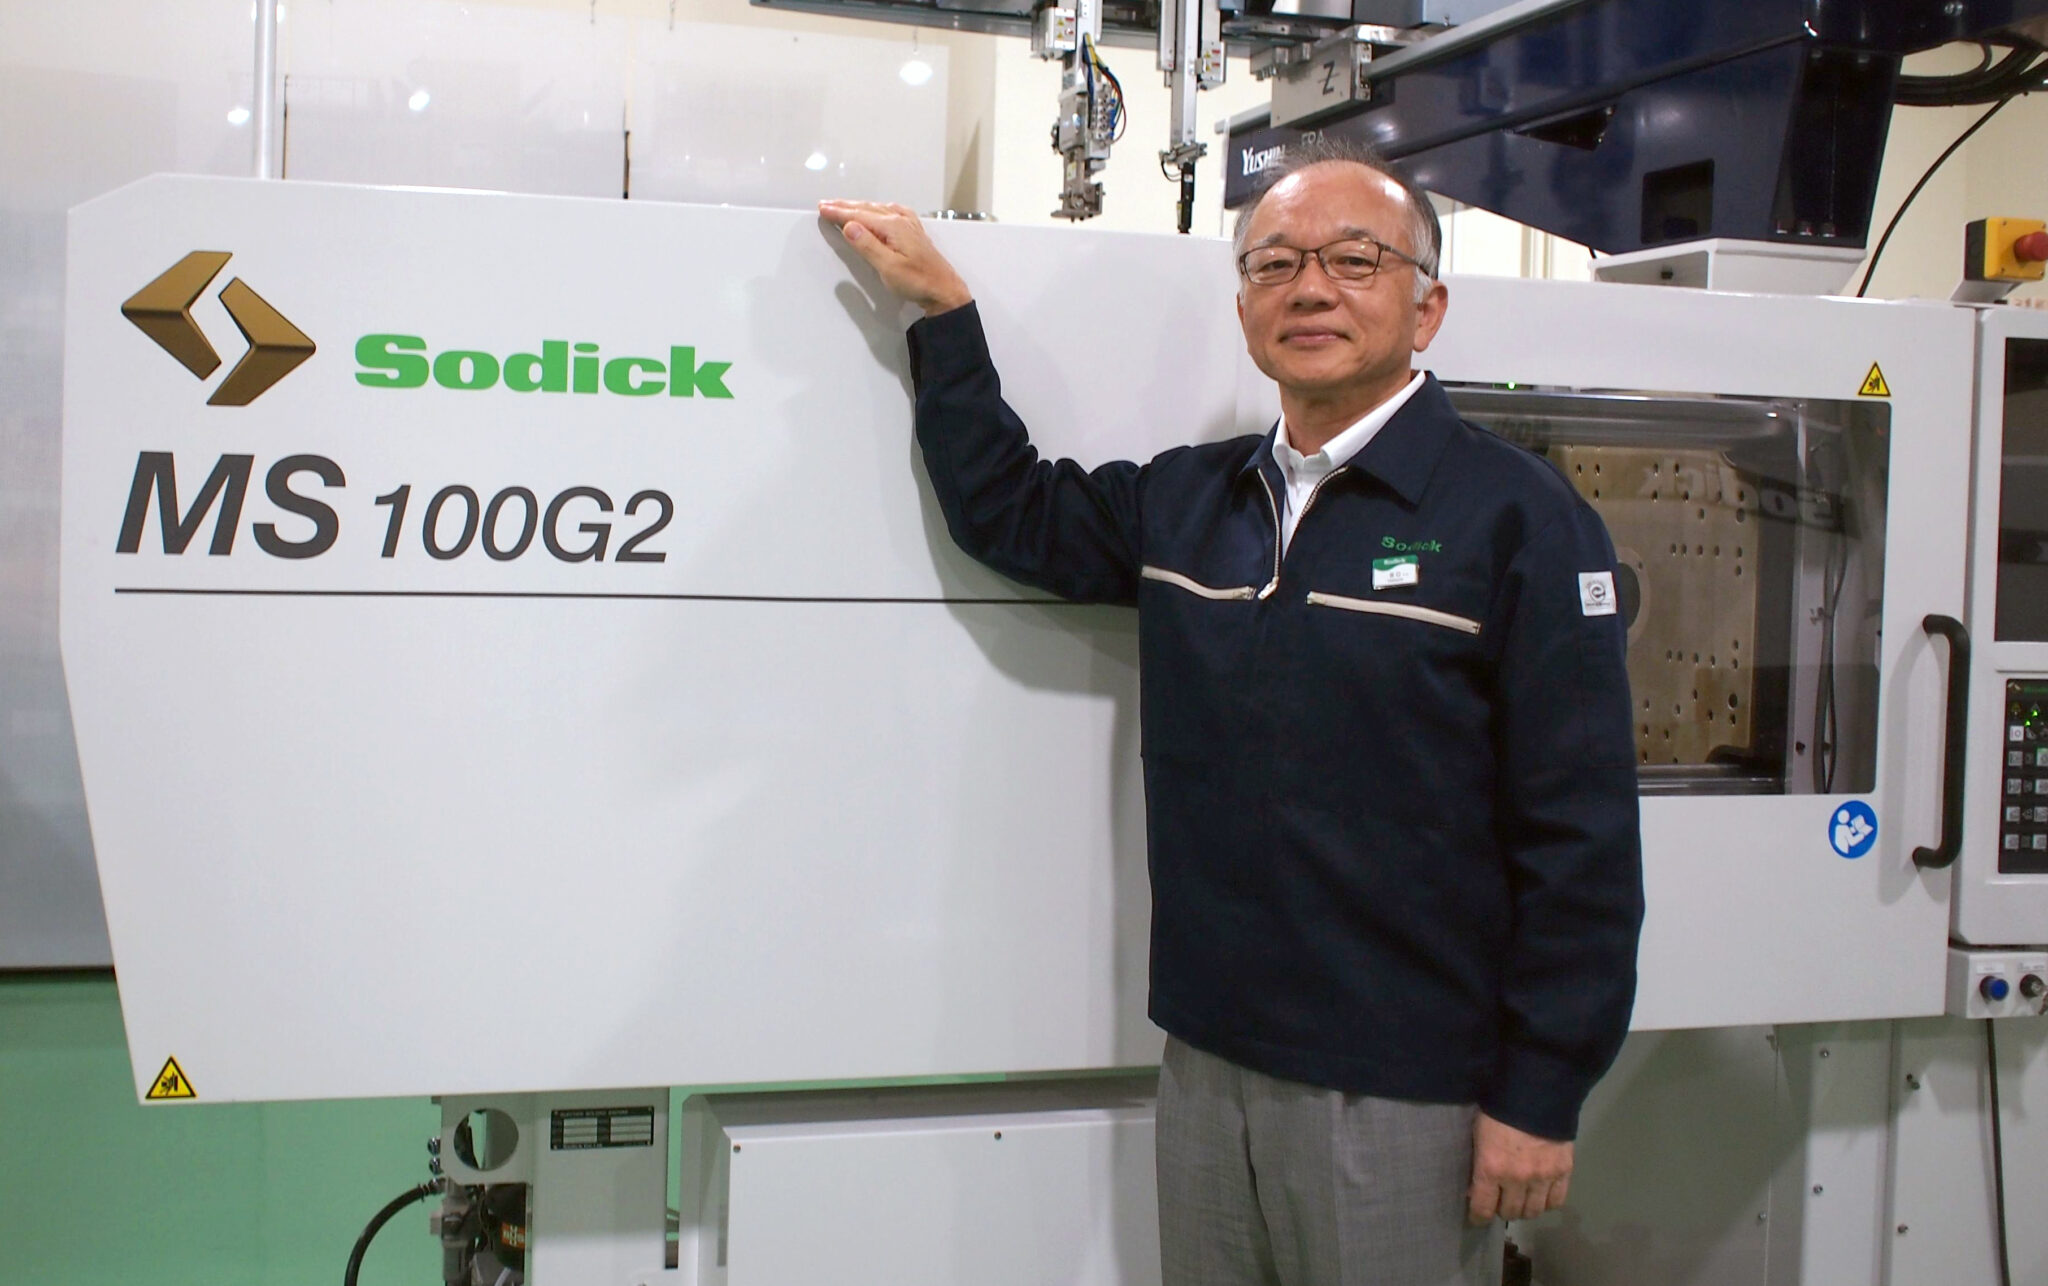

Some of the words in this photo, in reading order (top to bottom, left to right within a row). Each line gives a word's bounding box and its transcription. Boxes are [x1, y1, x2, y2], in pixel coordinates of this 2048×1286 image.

[353, 332, 735, 399] Sodick
[115, 450, 347, 560] MS
[373, 484, 675, 564] 100G2
